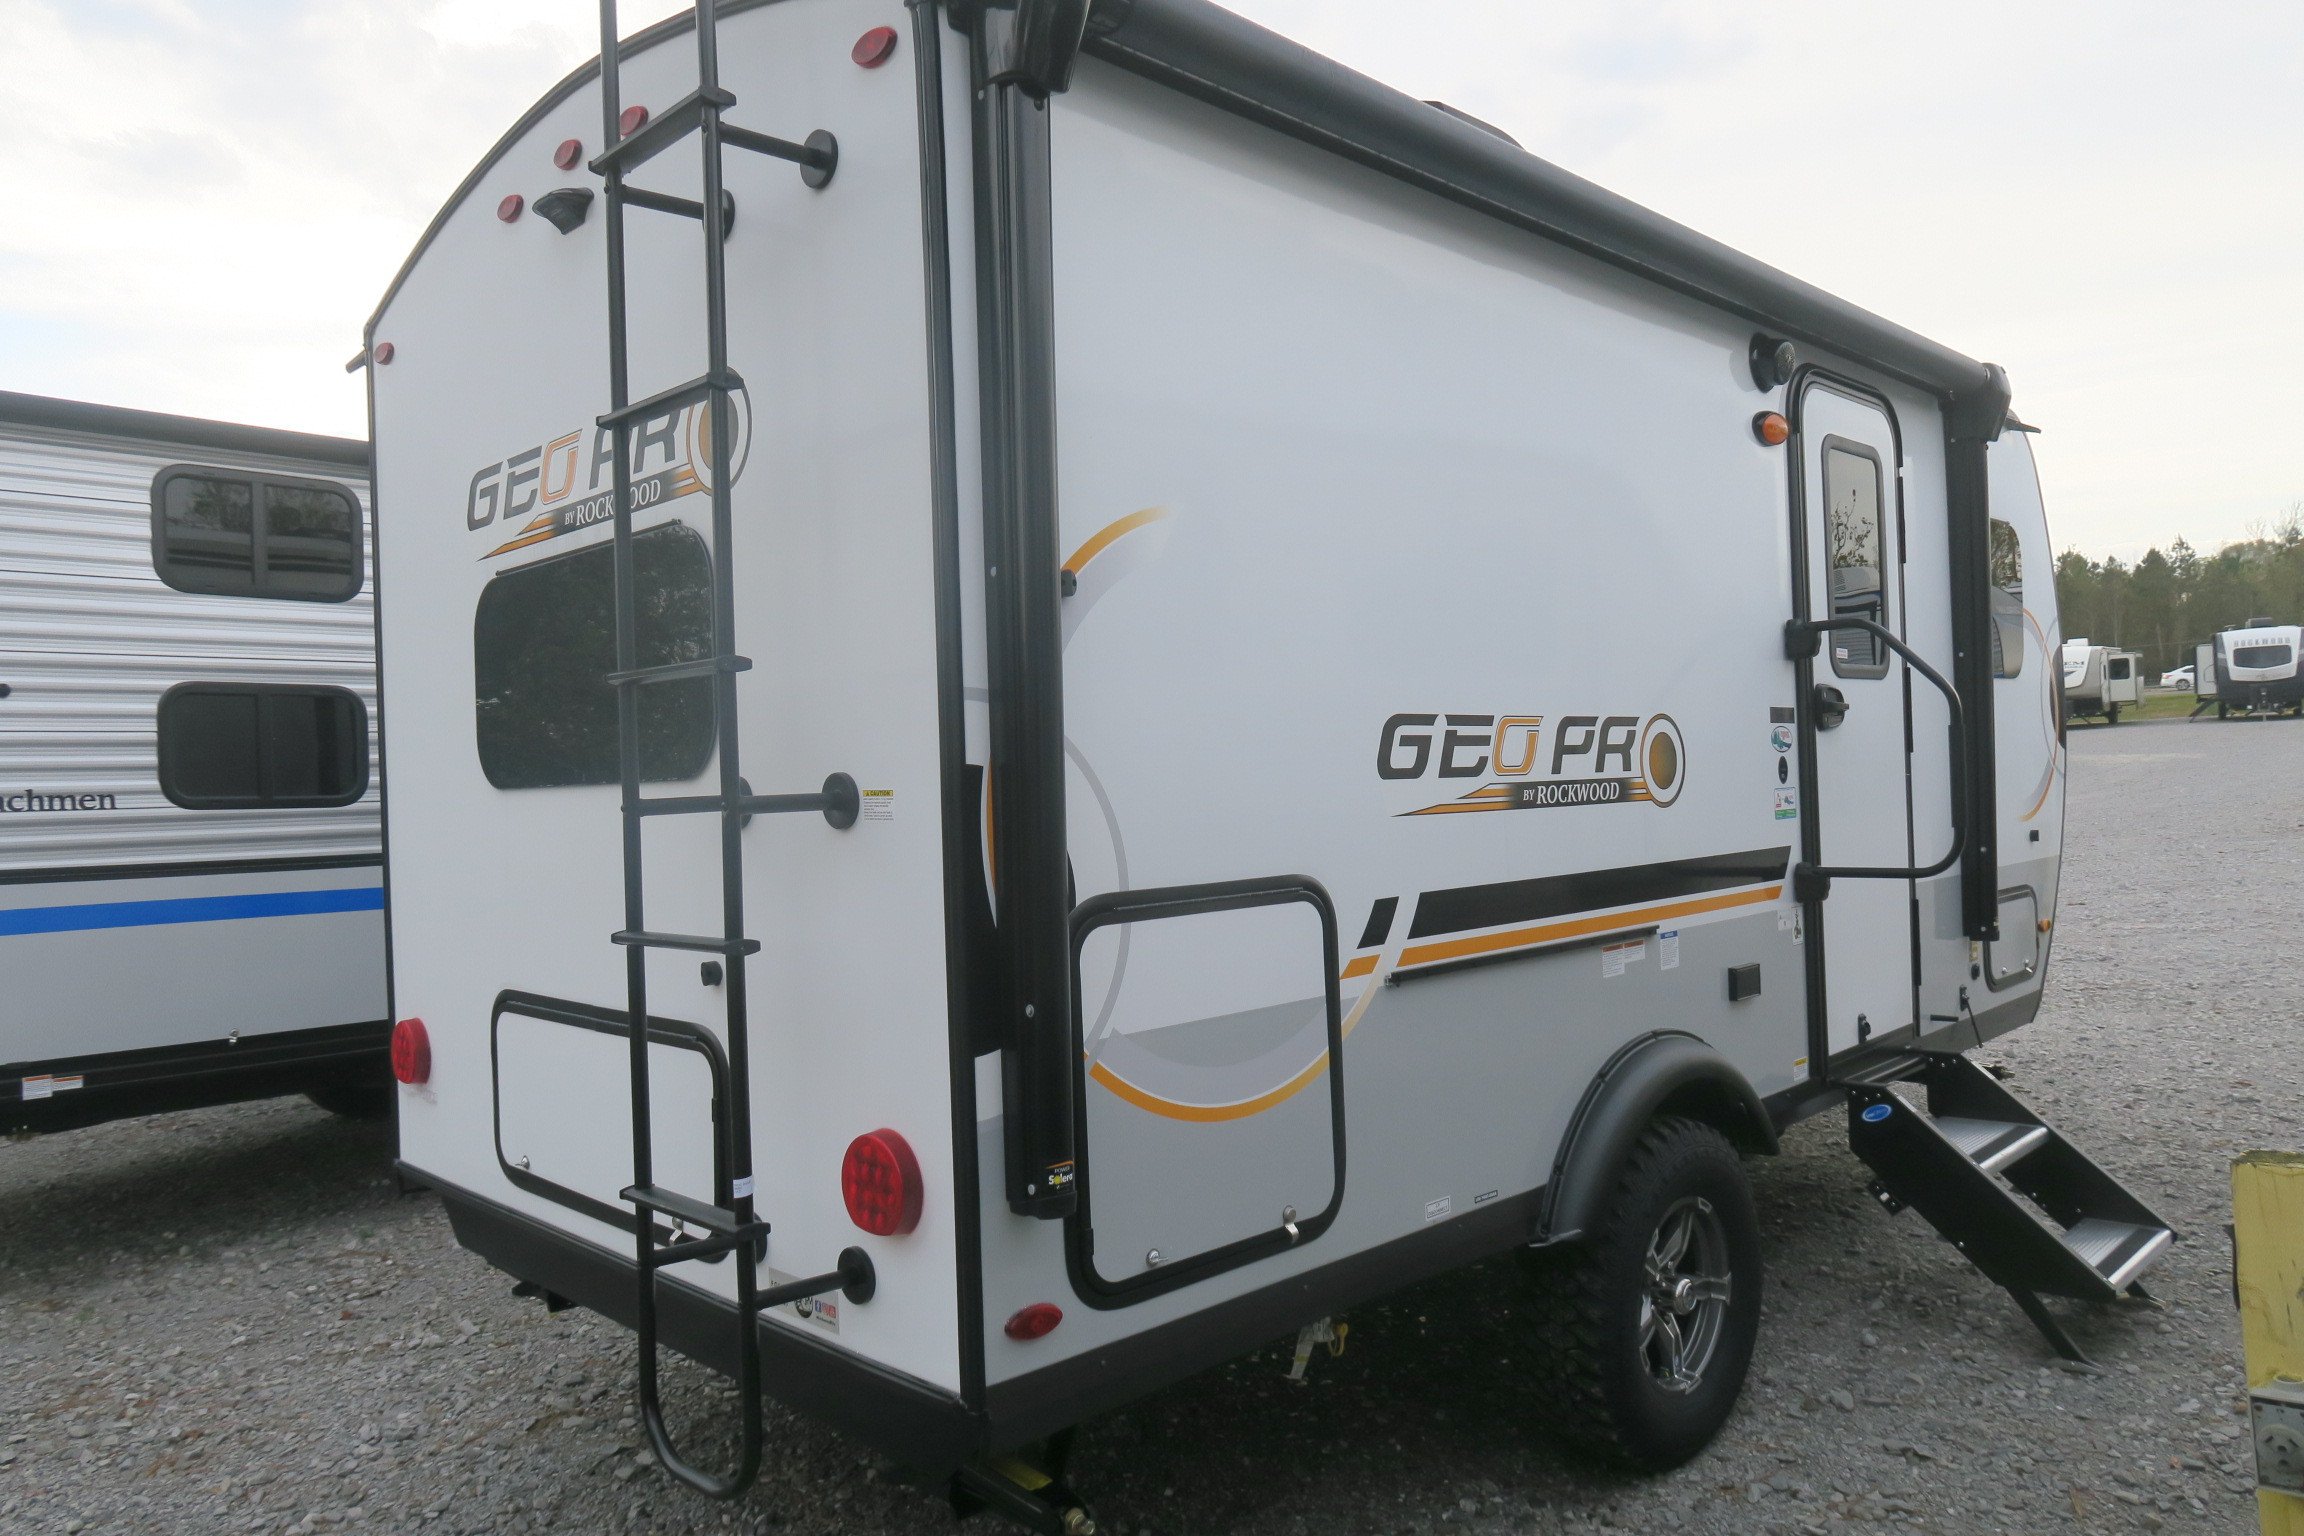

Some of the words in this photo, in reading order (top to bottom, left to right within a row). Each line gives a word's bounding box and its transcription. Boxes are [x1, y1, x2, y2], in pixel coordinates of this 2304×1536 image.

[467, 428, 583, 531] GEO
[564, 511, 575, 525] BY
[575, 479, 661, 526] ROCKOOD
[1376, 713, 1544, 780] GEO
[1551, 713, 1686, 808] PRO
[1523, 789, 1535, 801] BY
[1536, 782, 1620, 804] ROCKWOOD
